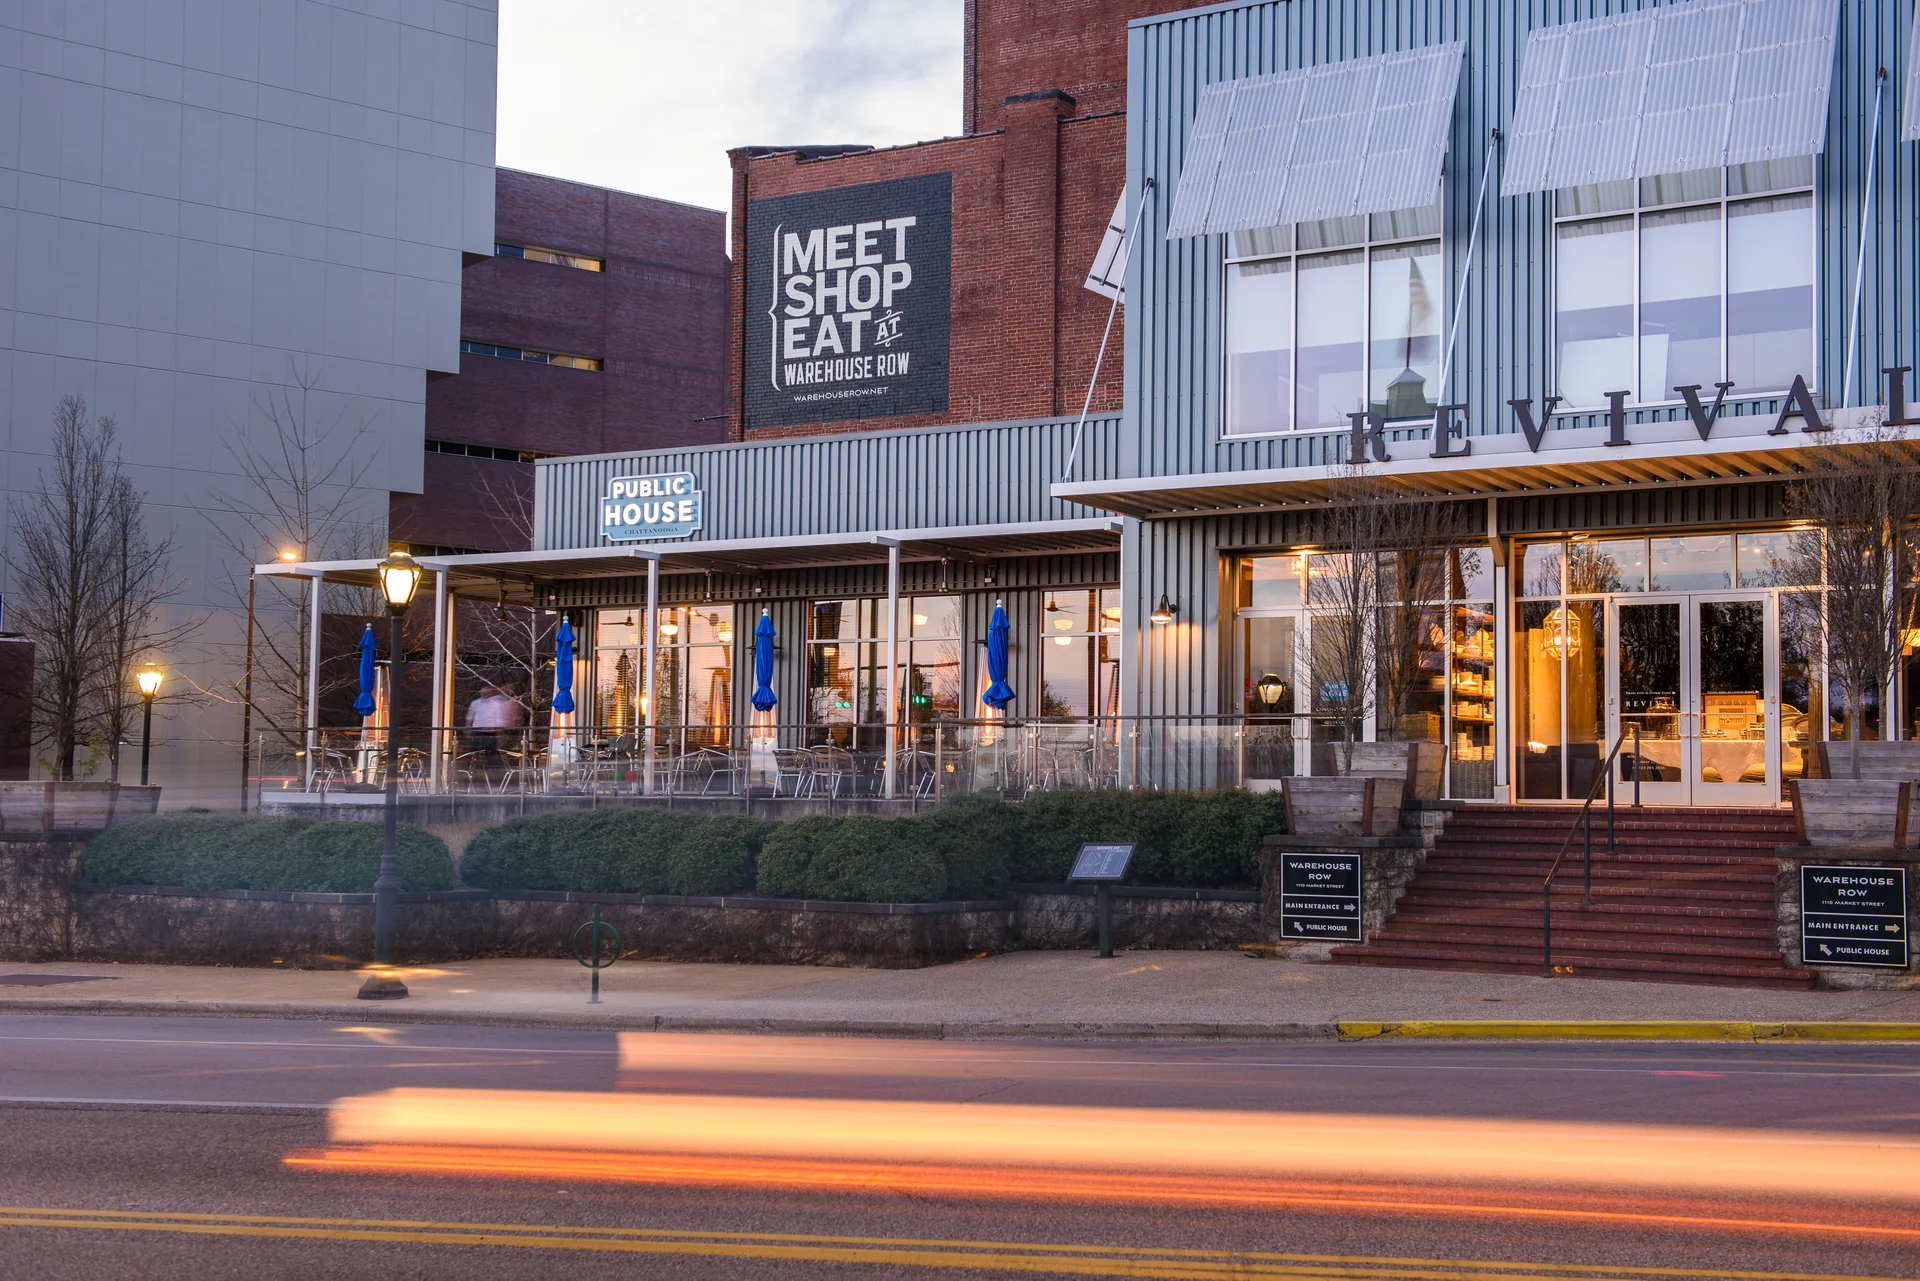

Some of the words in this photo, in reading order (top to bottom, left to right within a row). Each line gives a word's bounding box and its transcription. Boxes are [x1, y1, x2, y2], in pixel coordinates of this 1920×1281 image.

[784, 216, 916, 275] MEET
[784, 262, 912, 317] SHOP
[784, 311, 872, 359] EAT
[876, 316, 901, 342] AT
[784, 356, 873, 386] WAREHOUSE
[877, 352, 910, 377] ROW
[793, 386, 889, 402] WAREHOUSEROW.NET
[1346, 365, 1920, 464] REVIVAL
[612, 477, 686, 499] PUBLIC
[605, 499, 693, 526] HOUSE
[624, 527, 679, 535] CHATTANOOGA
[1289, 862, 1352, 870] WAREHOUSE
[1812, 876, 1894, 886] WAREHOUSE
[1838, 889, 1868, 897] ROW
[1833, 923, 1879, 931] ENTRANCE
[1836, 946, 1862, 954] PUBLIC
[1863, 948, 1890, 956] HOUSE
